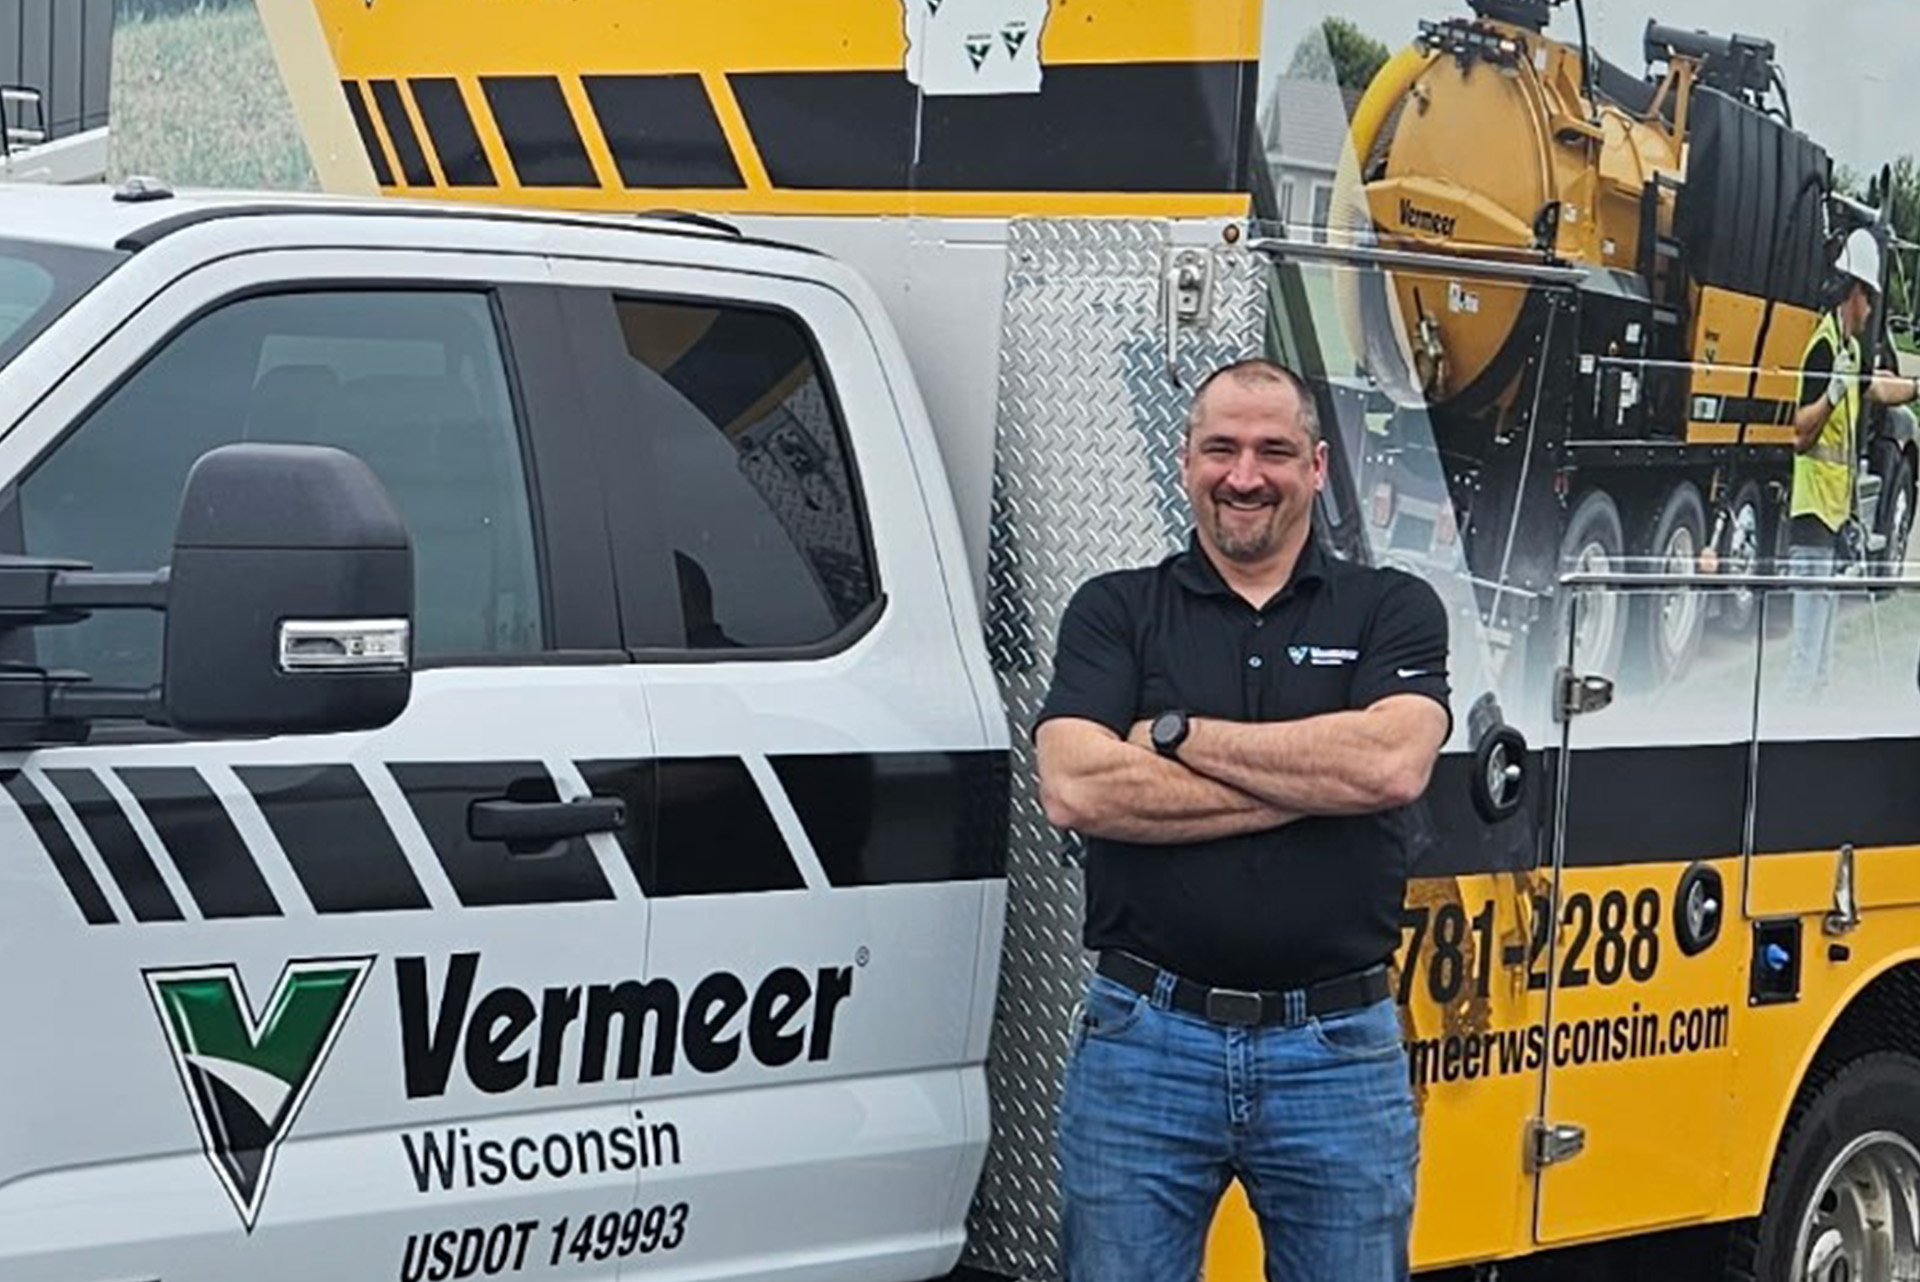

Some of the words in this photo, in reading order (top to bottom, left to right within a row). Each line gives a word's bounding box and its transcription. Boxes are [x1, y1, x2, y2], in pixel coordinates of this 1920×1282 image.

[1399, 198, 1456, 237] Vermeer
[394, 951, 854, 1099] Vermeer
[401, 1109, 682, 1193] Wisconsin
[400, 1219, 540, 1282] USDOT
[549, 1202, 690, 1266] 149993
